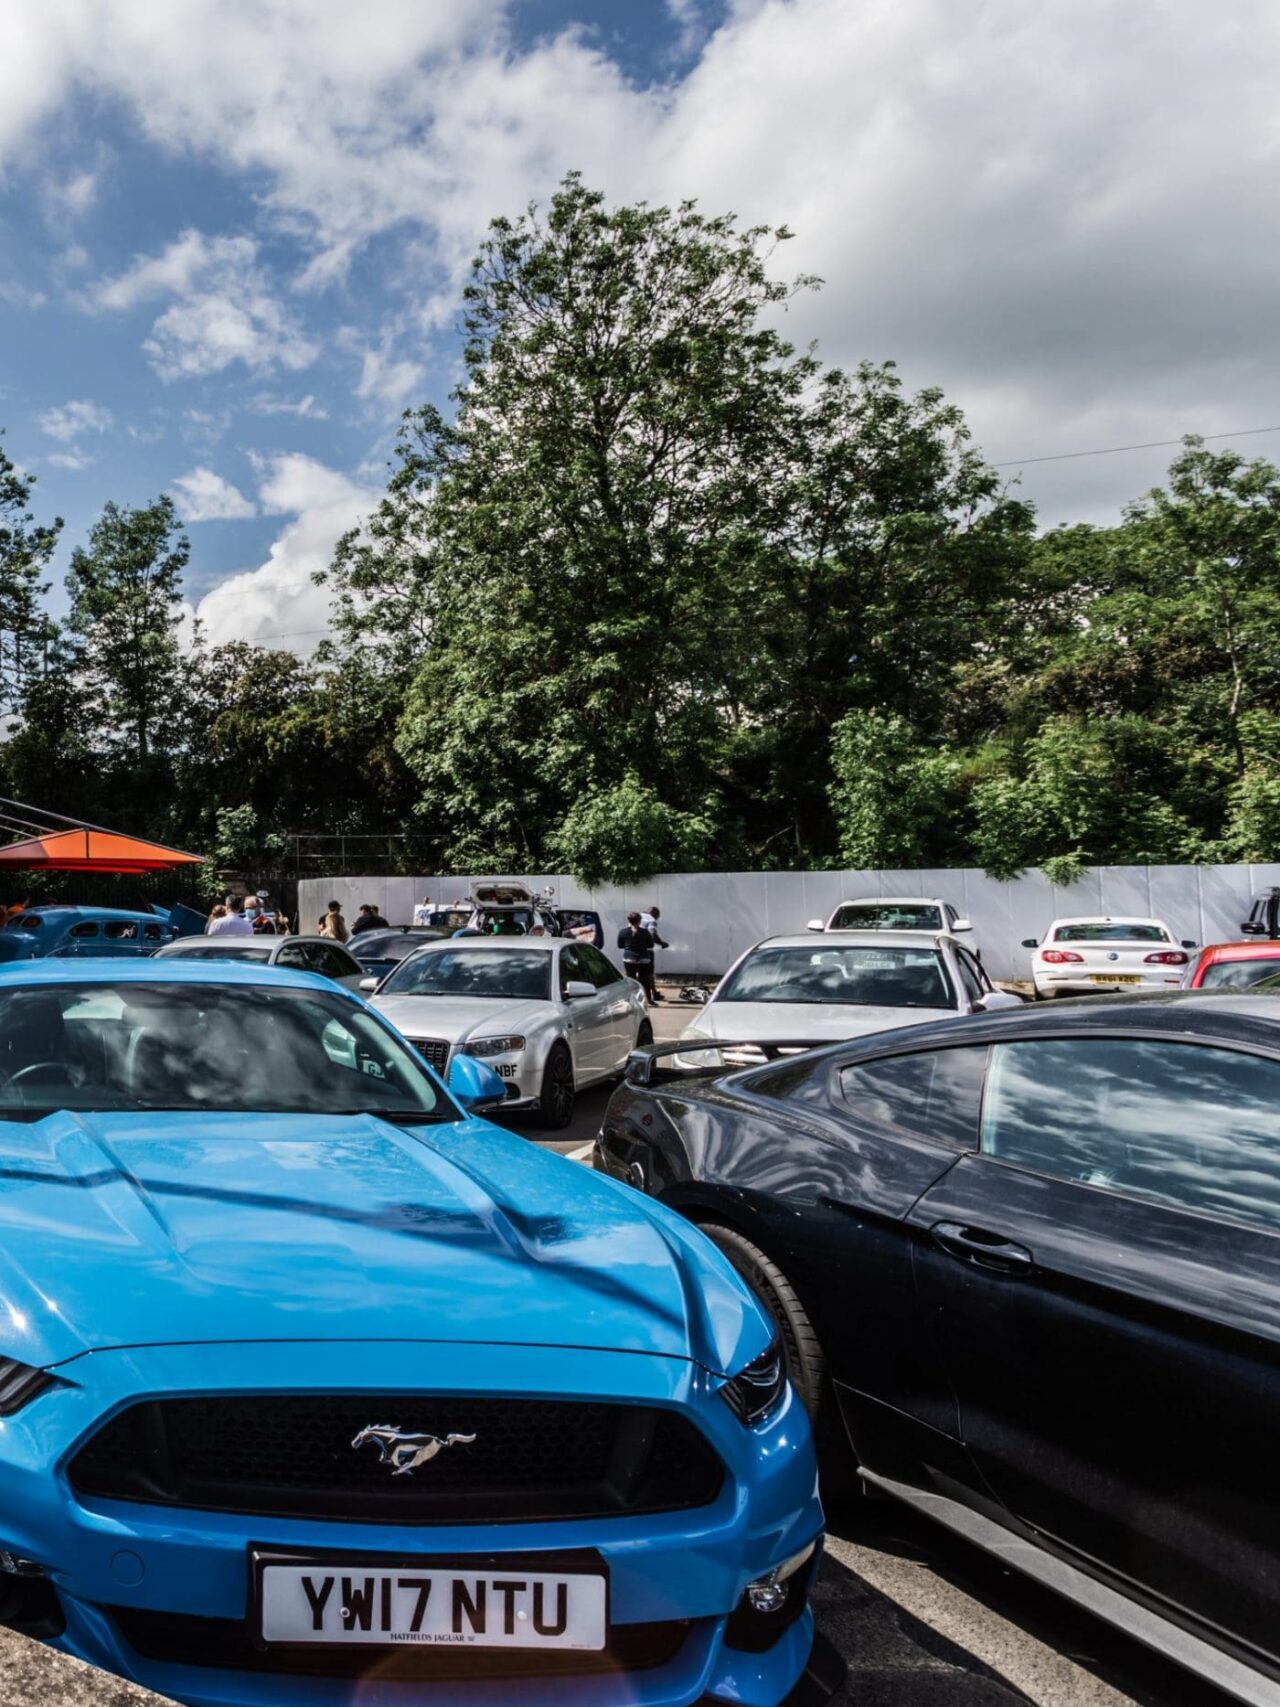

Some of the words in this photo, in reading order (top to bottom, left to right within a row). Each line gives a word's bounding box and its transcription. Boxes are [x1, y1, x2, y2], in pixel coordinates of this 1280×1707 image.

[494, 1064, 518, 1077] NBF
[301, 1576, 432, 1632] YW17
[451, 1579, 568, 1636] NTU
[390, 1633, 432, 1641] HATFIELDS
[434, 1633, 464, 1642] JAGUAR
